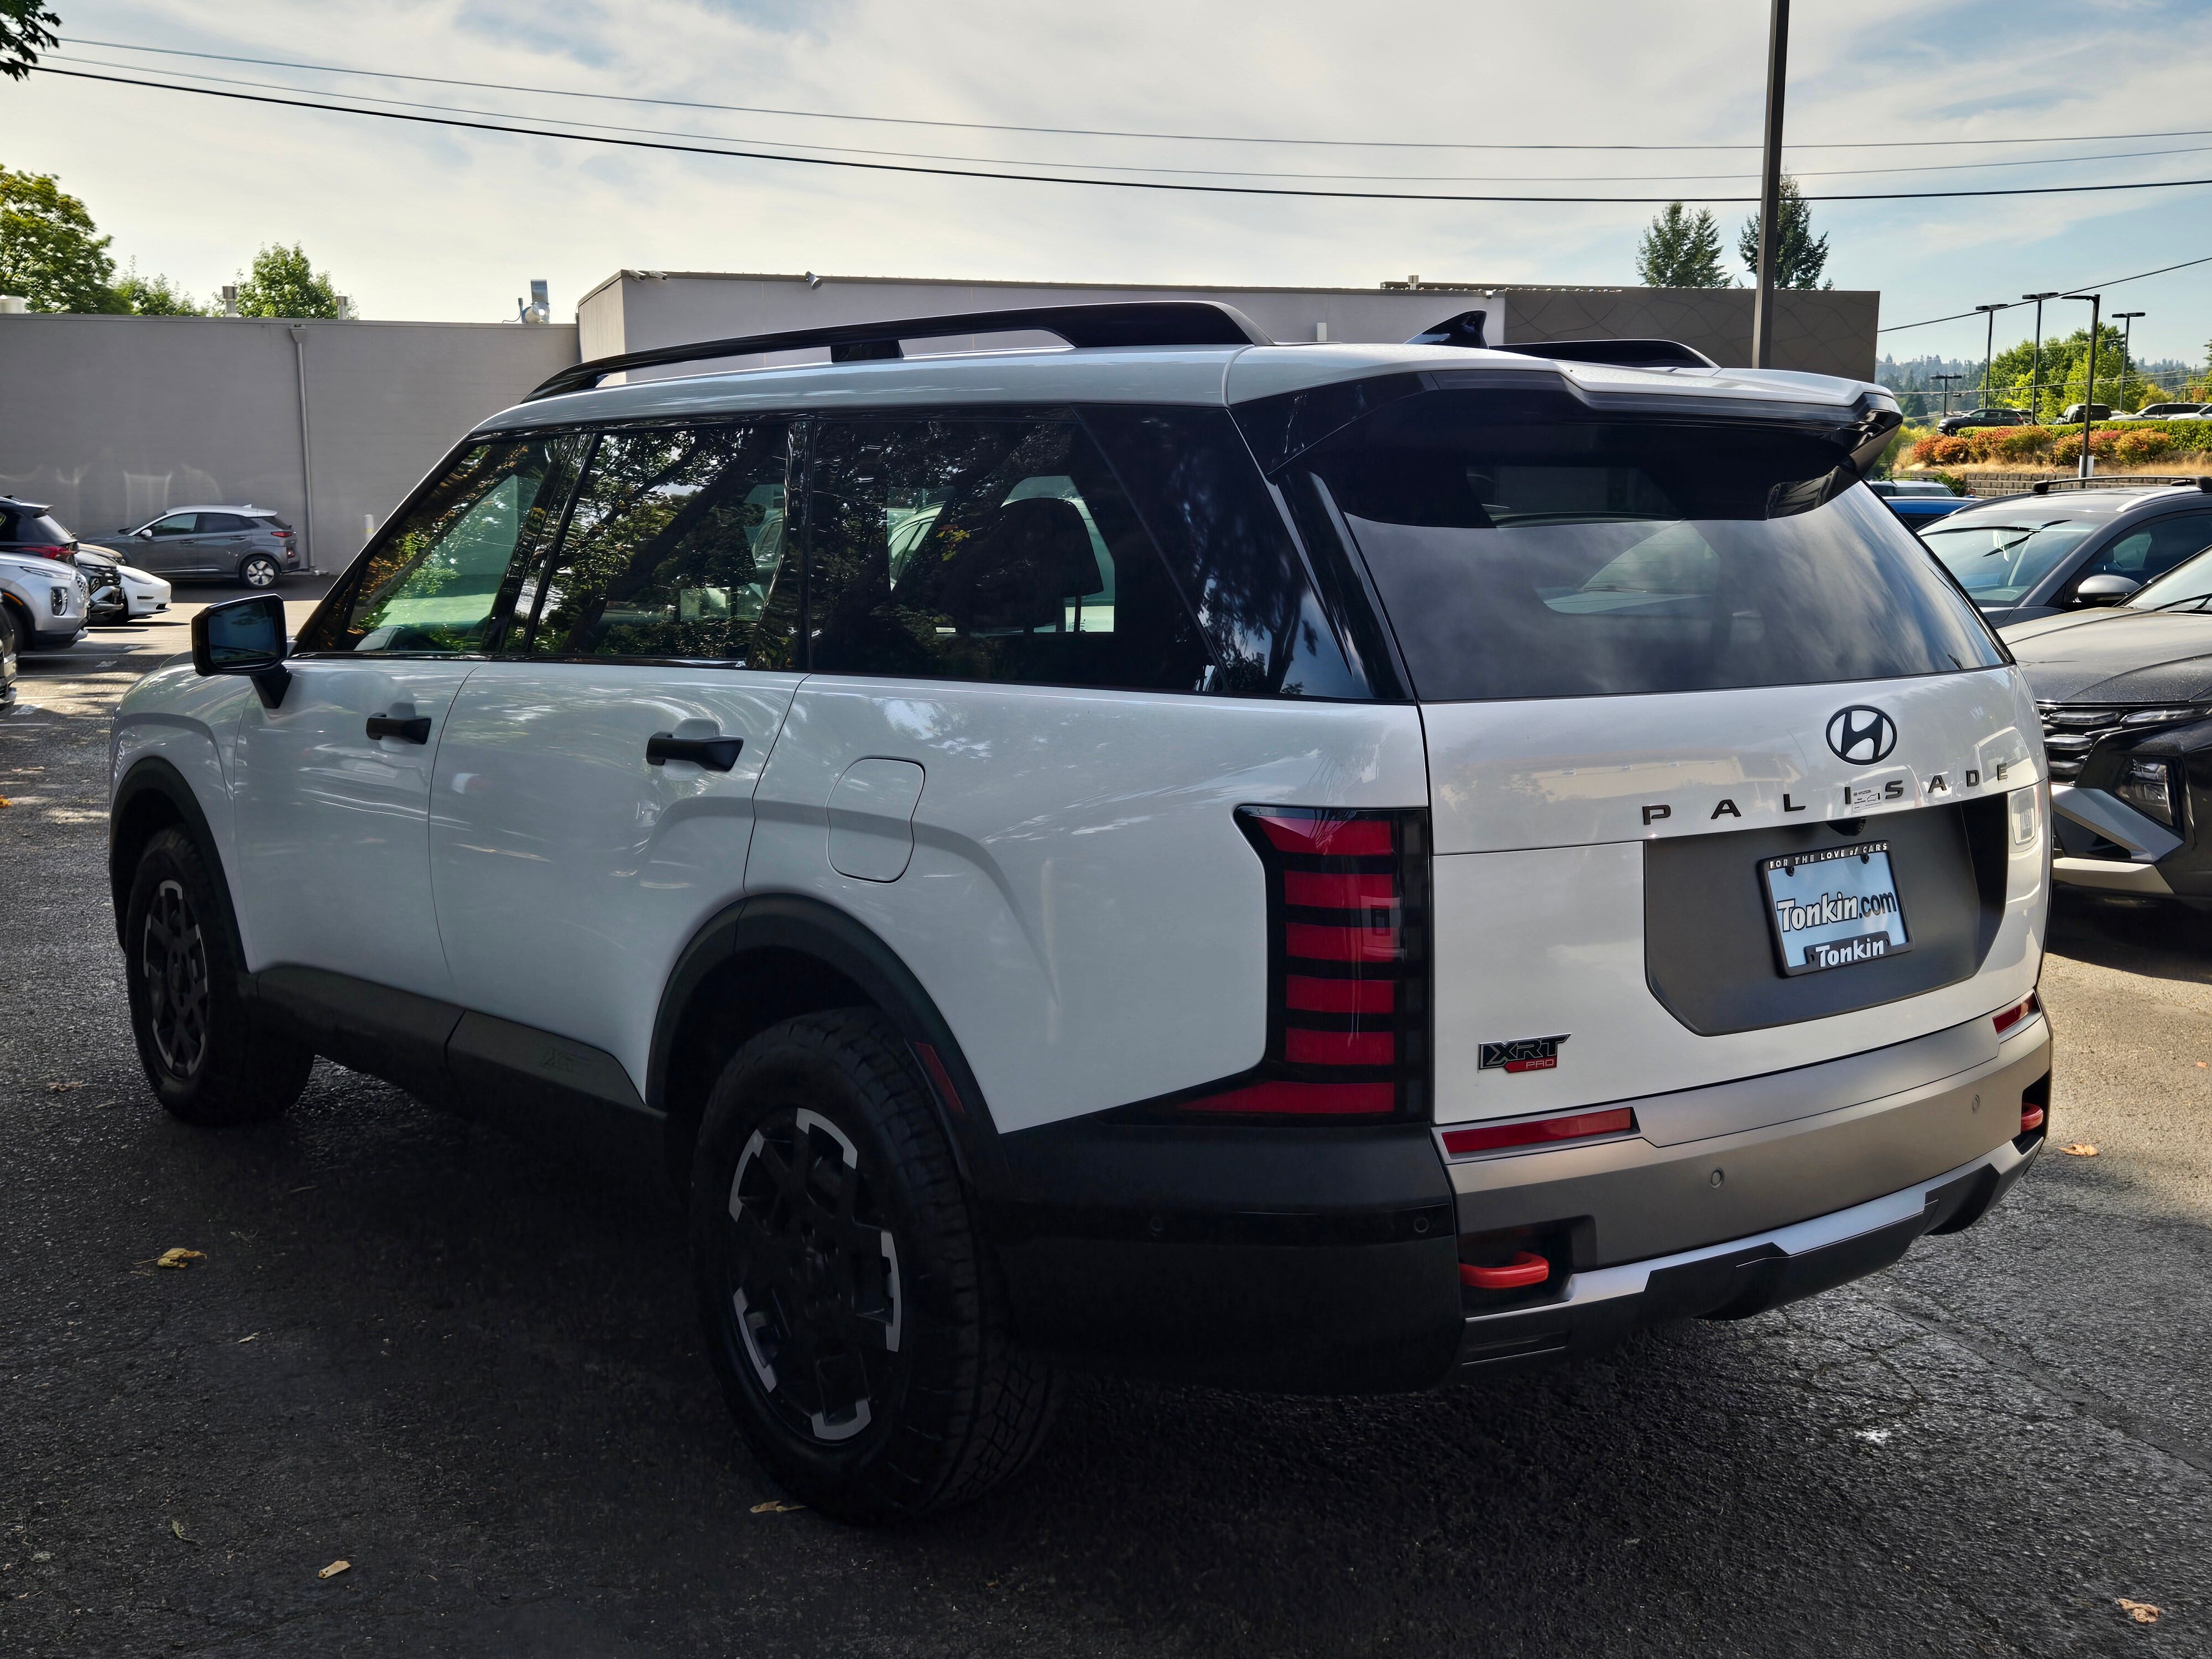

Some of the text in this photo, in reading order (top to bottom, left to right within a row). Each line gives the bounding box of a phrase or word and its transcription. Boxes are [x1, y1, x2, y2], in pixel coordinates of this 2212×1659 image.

[1642, 763, 2008, 826] PALISADE
[1820, 849, 1845, 860] LOVE
[1863, 843, 1887, 853] CARS
[1776, 891, 1897, 932] Tonkin.com
[1815, 938, 1885, 967] Tonkin
[1526, 1059, 1554, 1069] PRO
